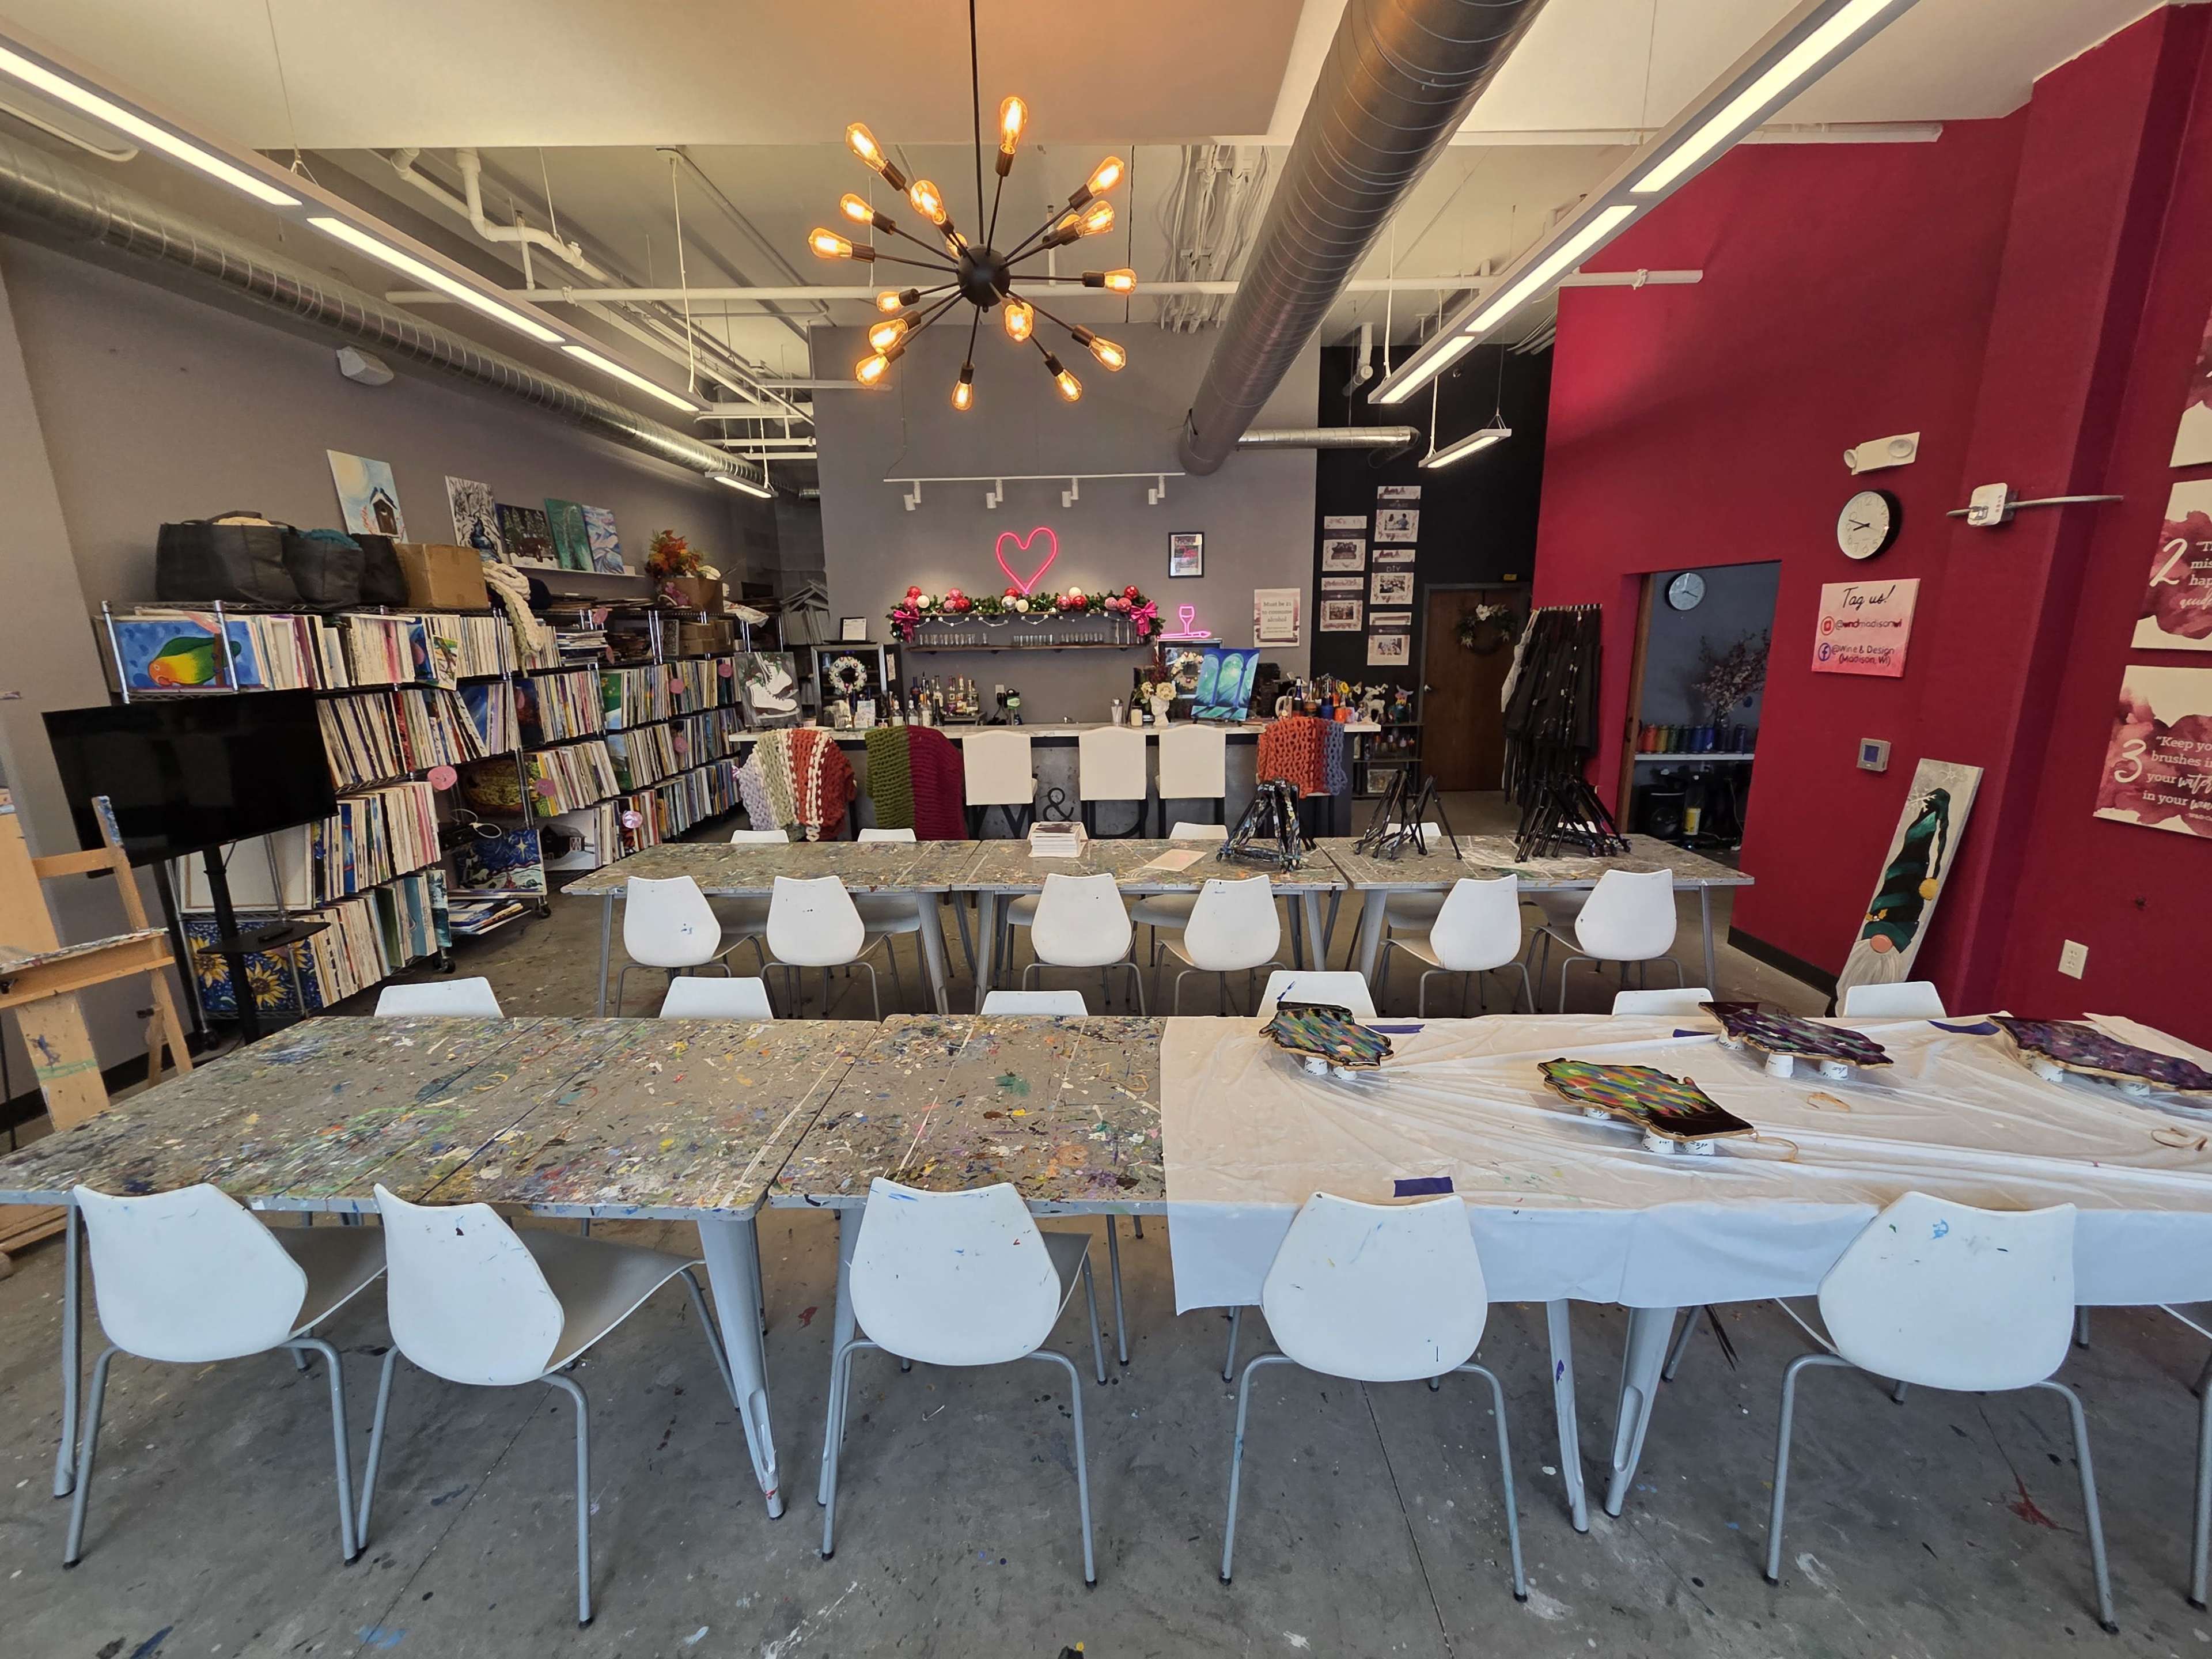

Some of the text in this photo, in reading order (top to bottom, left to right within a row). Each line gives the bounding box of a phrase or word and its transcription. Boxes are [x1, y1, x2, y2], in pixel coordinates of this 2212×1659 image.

[2149, 538, 2188, 587] 2
[1843, 585, 1896, 611] Tag us!
[1867, 645, 1895, 656] Design
[2114, 738, 2146, 782] 3
[2152, 750, 2201, 766] brushes
[2146, 773, 2177, 783] your
[2142, 790, 2156, 801] in
[2157, 794, 2189, 806] your
